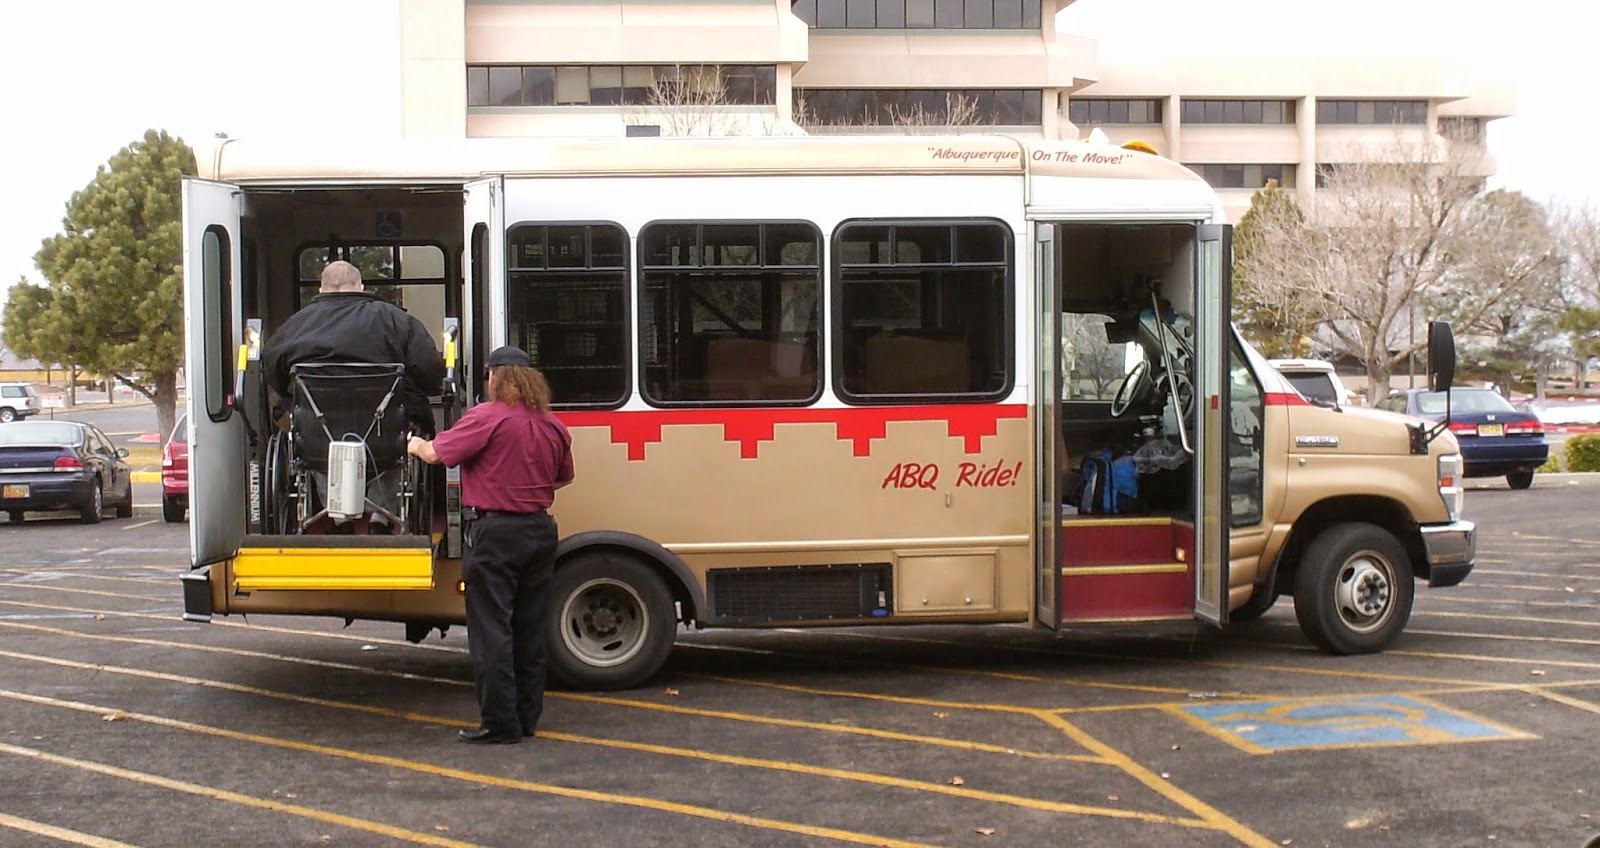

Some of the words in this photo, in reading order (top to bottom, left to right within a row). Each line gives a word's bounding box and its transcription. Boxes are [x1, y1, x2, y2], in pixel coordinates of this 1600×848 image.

[1031, 149, 1051, 161] On
[1055, 151, 1078, 163] The
[882, 463, 939, 490] ABQ
[956, 459, 1023, 487] Ride!
[249, 460, 260, 524] MILLENNIUM
